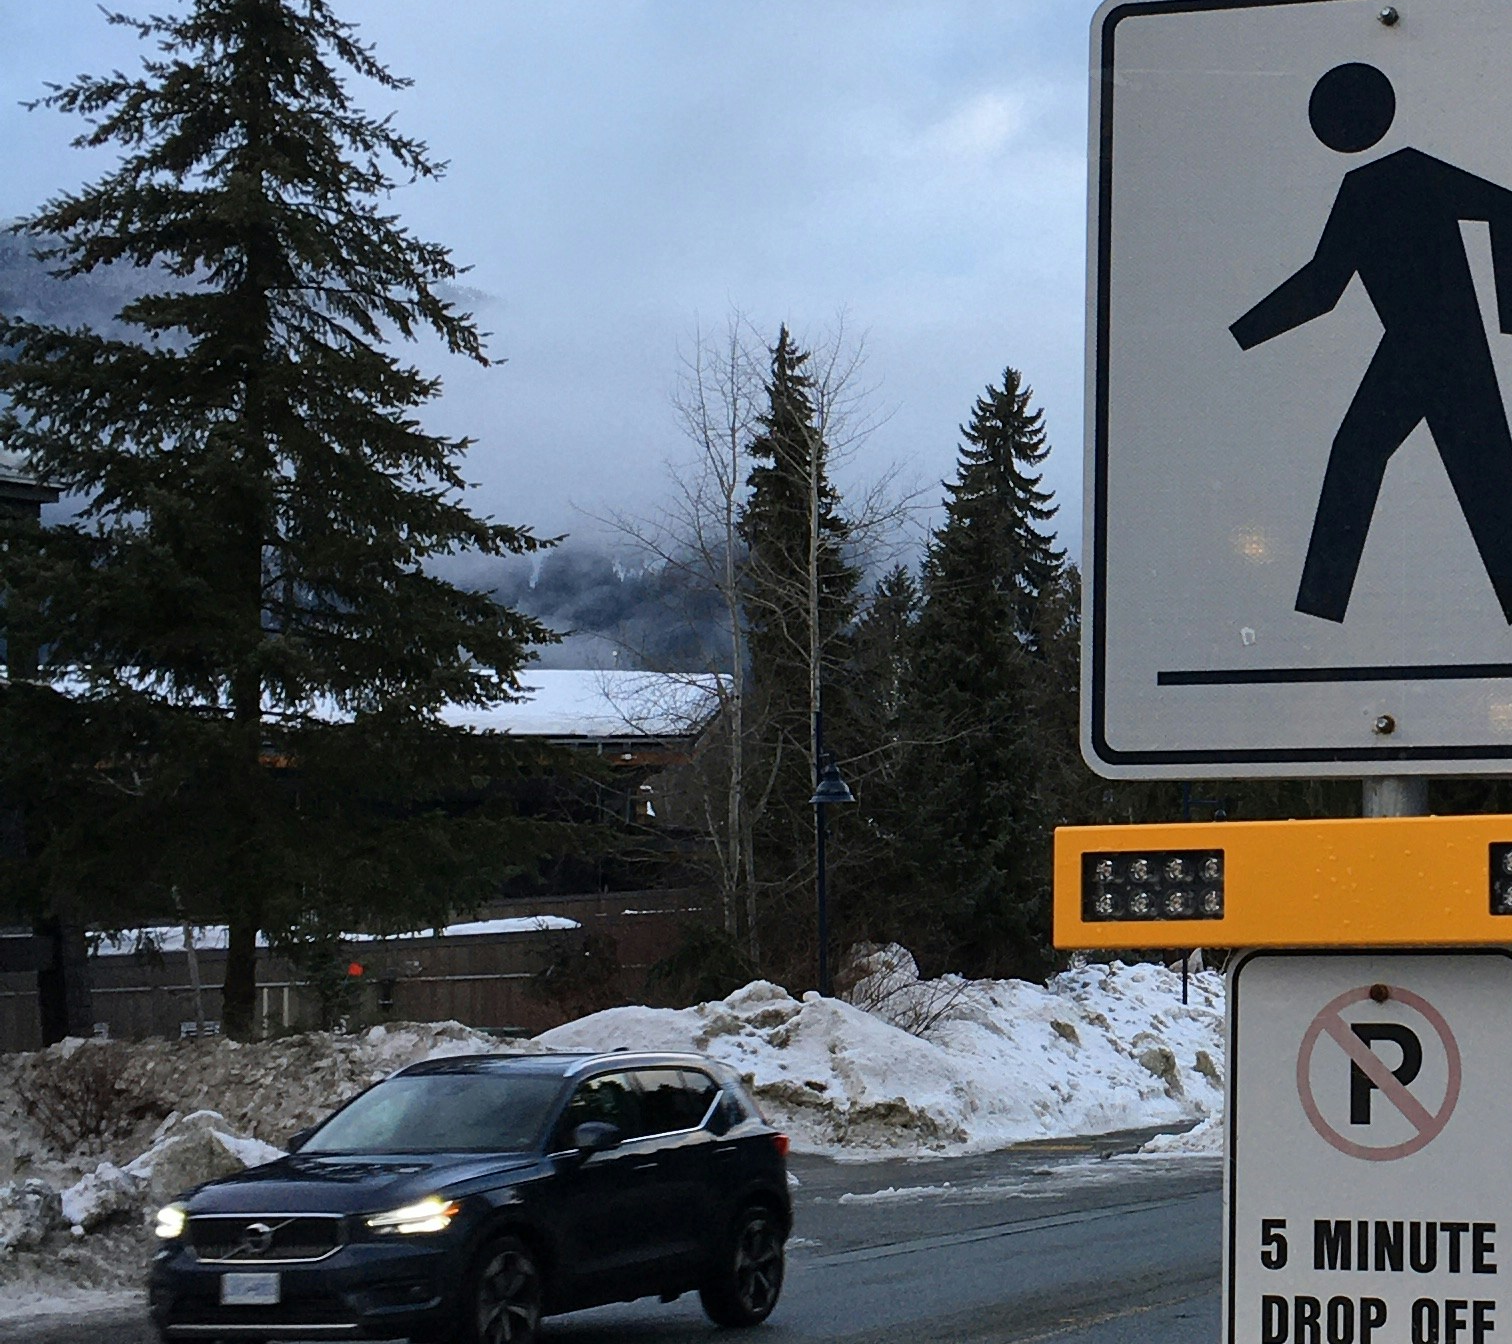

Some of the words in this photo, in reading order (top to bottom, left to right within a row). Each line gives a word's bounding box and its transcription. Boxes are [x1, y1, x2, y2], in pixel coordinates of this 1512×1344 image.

[1350, 1022, 1423, 1126] P
[1260, 1218, 1288, 1271] 5
[1313, 1219, 1498, 1274] MINUTE
